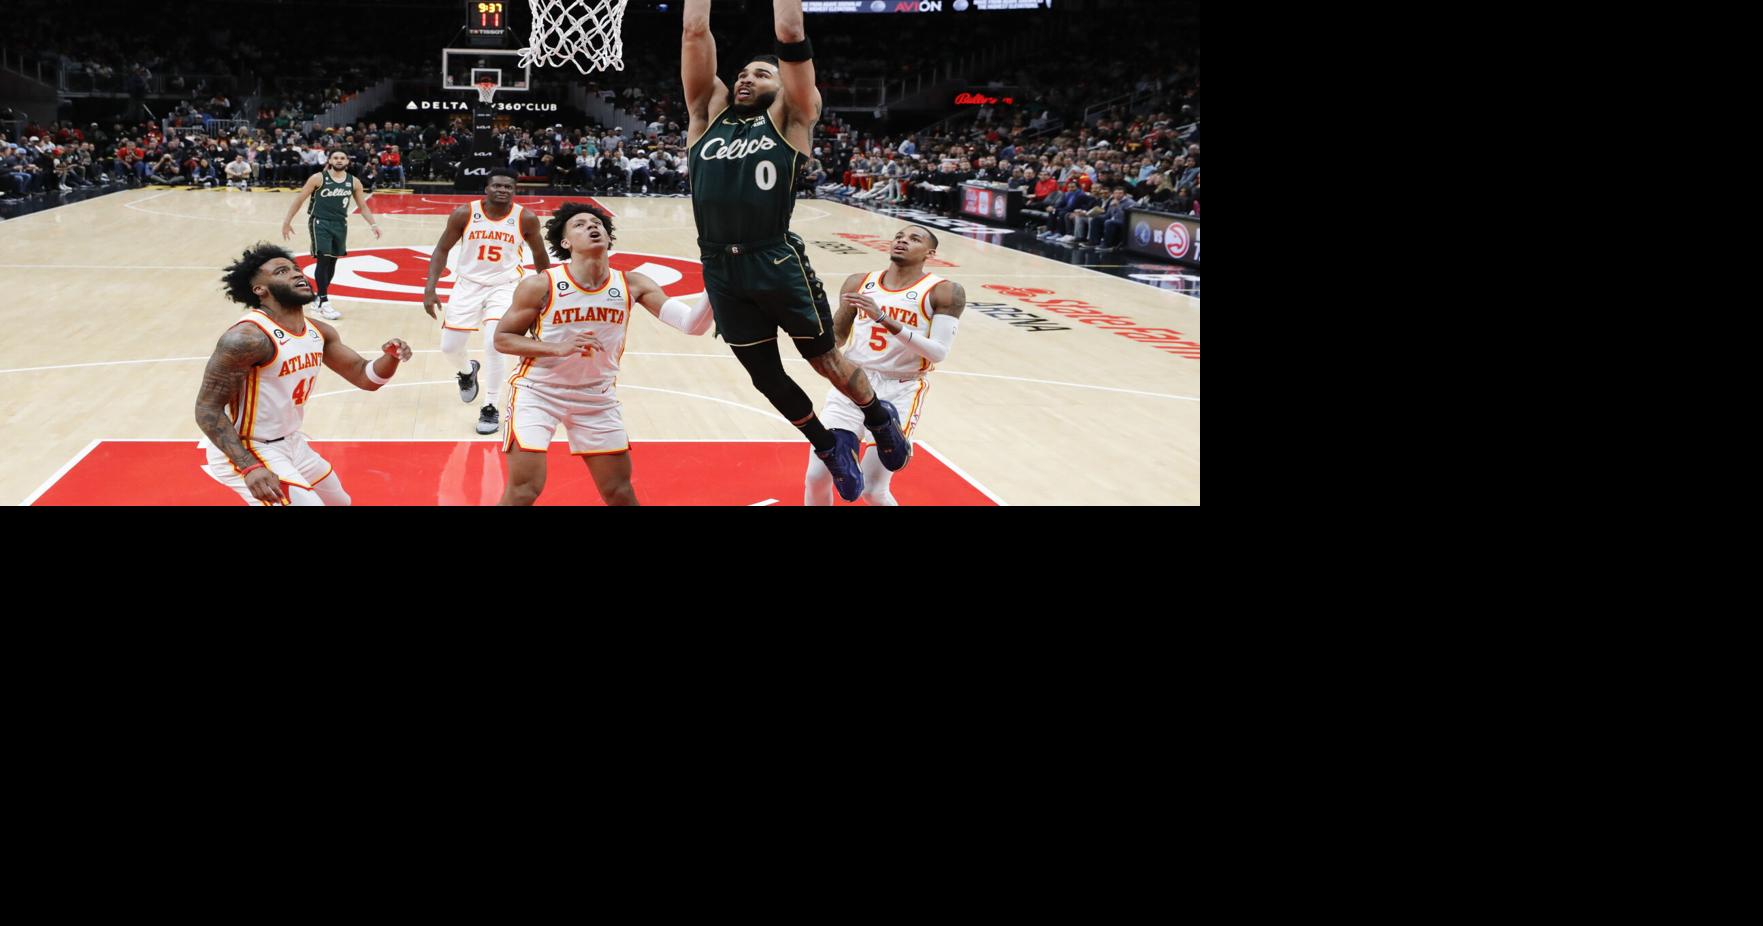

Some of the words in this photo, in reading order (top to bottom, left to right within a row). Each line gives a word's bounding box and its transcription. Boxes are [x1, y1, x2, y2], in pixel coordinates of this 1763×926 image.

[478, 3, 502, 13] 9:37
[482, 13, 499, 26] 11
[421, 101, 468, 110] DELTA
[700, 135, 777, 160] Celtcs
[755, 160, 777, 191] 0
[321, 188, 352, 197] Celtics
[342, 197, 349, 208] 9
[468, 230, 515, 244] ATLANTA
[477, 244, 502, 262] 15
[552, 307, 625, 325] ATLANTA
[966, 301, 1072, 332] ARENA
[869, 326, 888, 352] 5
[278, 352, 323, 377] ATLANT
